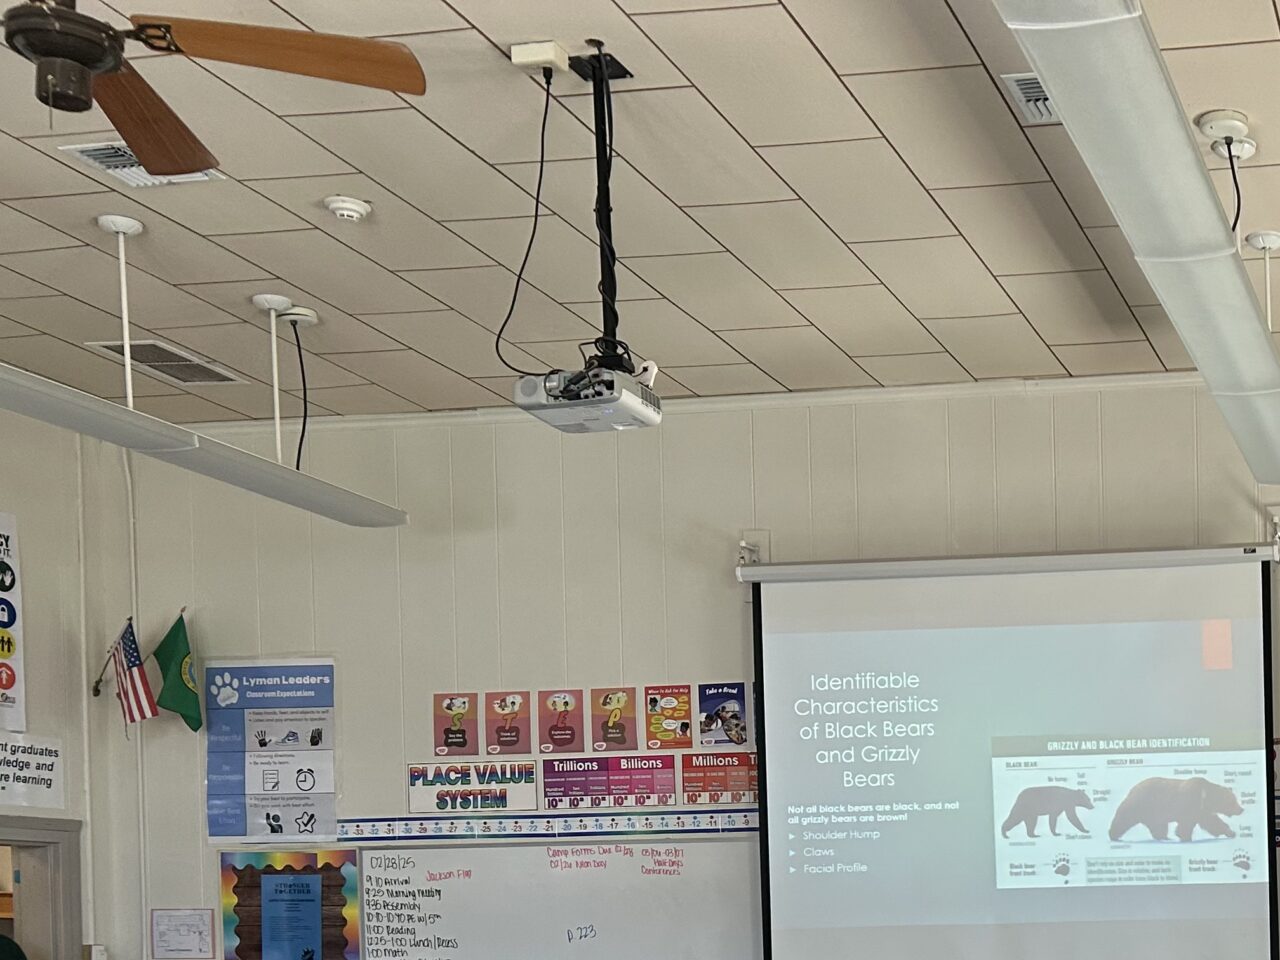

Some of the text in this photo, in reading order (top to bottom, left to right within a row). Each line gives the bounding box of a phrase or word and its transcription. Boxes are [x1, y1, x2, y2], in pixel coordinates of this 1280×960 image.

[243, 674, 330, 688] Lyman Leaders
[810, 672, 920, 691] Identifiable
[794, 696, 939, 716] Characteristics
[451, 712, 464, 730] S
[503, 712, 518, 729] T
[556, 710, 568, 727] E
[608, 708, 621, 727] P
[800, 721, 935, 739] of Black Bears
[10, 744, 59, 758] graduates
[1048, 738, 1210, 751] GRIZZLY AND BLACK BEAR IDENTIFICATION
[692, 754, 739, 766] Millions
[816, 745, 920, 765] and Grizzly
[35, 760, 54, 772] and
[553, 758, 662, 772] Trillions Billions
[12, 774, 52, 788] learning
[410, 763, 535, 786] PLACE VALUE
[843, 771, 895, 787] Bears
[436, 788, 508, 810] SYSTEM
[788, 805, 804, 814] Not
[819, 804, 846, 813] black
[848, 804, 874, 812] bears
[924, 802, 942, 810] and
[945, 801, 959, 810] not
[788, 816, 799, 824] all
[801, 815, 829, 825] grizzly
[832, 815, 857, 823] bears
[877, 813, 908, 821] brown!
[803, 830, 880, 840] Shoulder Hump
[547, 847, 569, 858] Camp
[571, 846, 595, 856] Forms
[804, 848, 834, 856] Claws
[370, 854, 416, 871] 02/28/25
[804, 863, 868, 873] Facial Profile
[385, 876, 410, 886] Arrival
[426, 870, 456, 881] Jackson
[383, 900, 420, 912] Assembly
[386, 926, 416, 936] Reading
[577, 924, 596, 940] 223
[384, 949, 408, 958] Math
